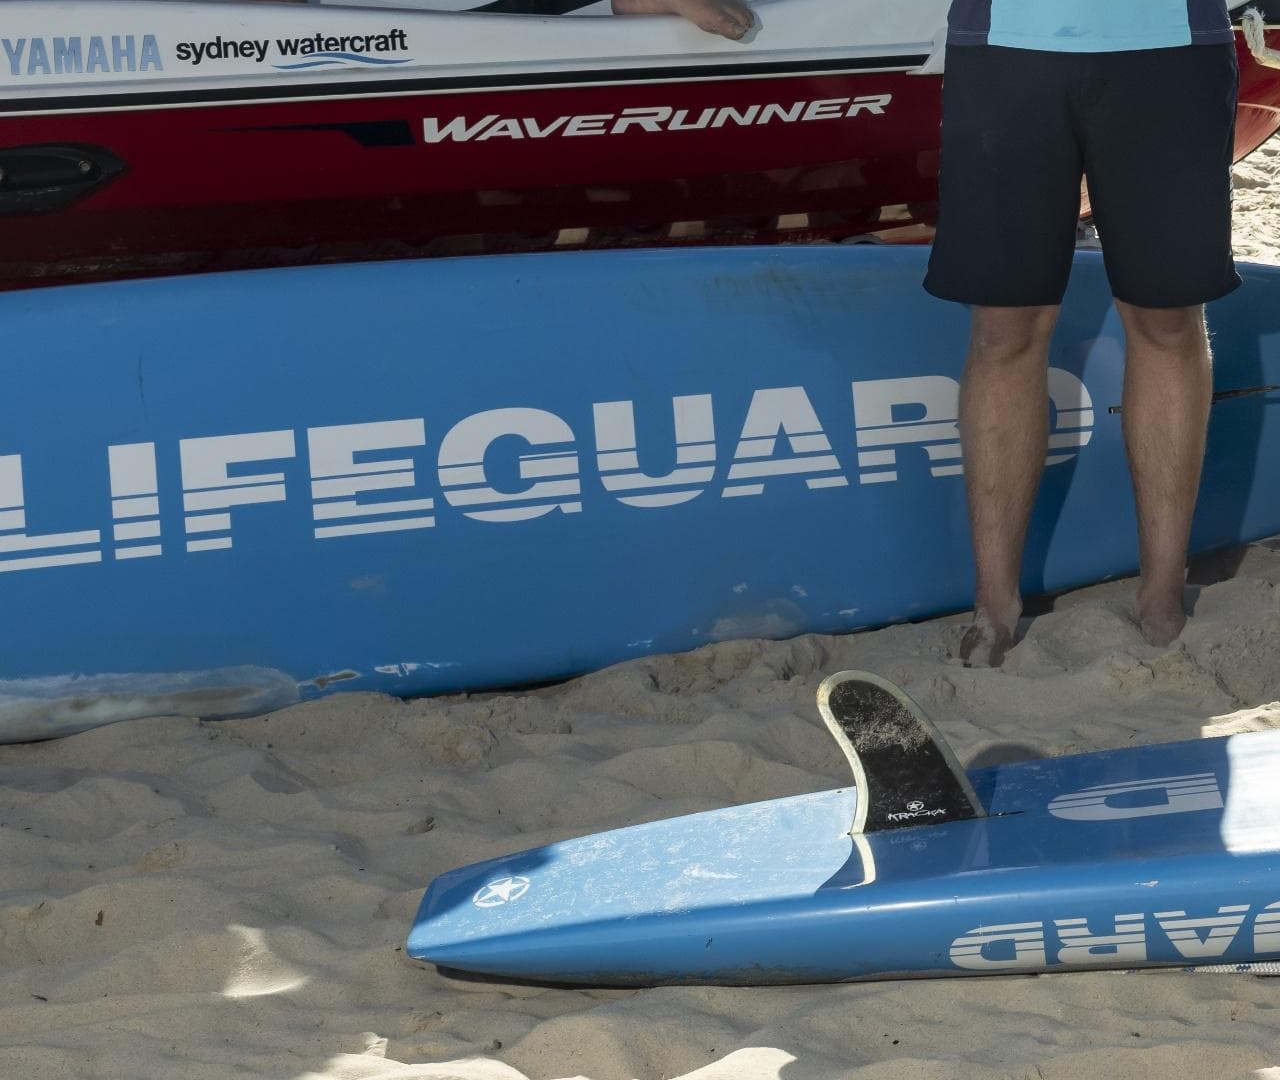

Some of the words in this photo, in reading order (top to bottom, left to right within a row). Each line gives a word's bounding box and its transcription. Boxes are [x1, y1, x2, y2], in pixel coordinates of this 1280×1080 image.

[1, 34, 164, 75] YAMAHA
[176, 35, 269, 64] sydney
[276, 29, 408, 56] watercraft
[886, 808, 947, 822] KRACKA
